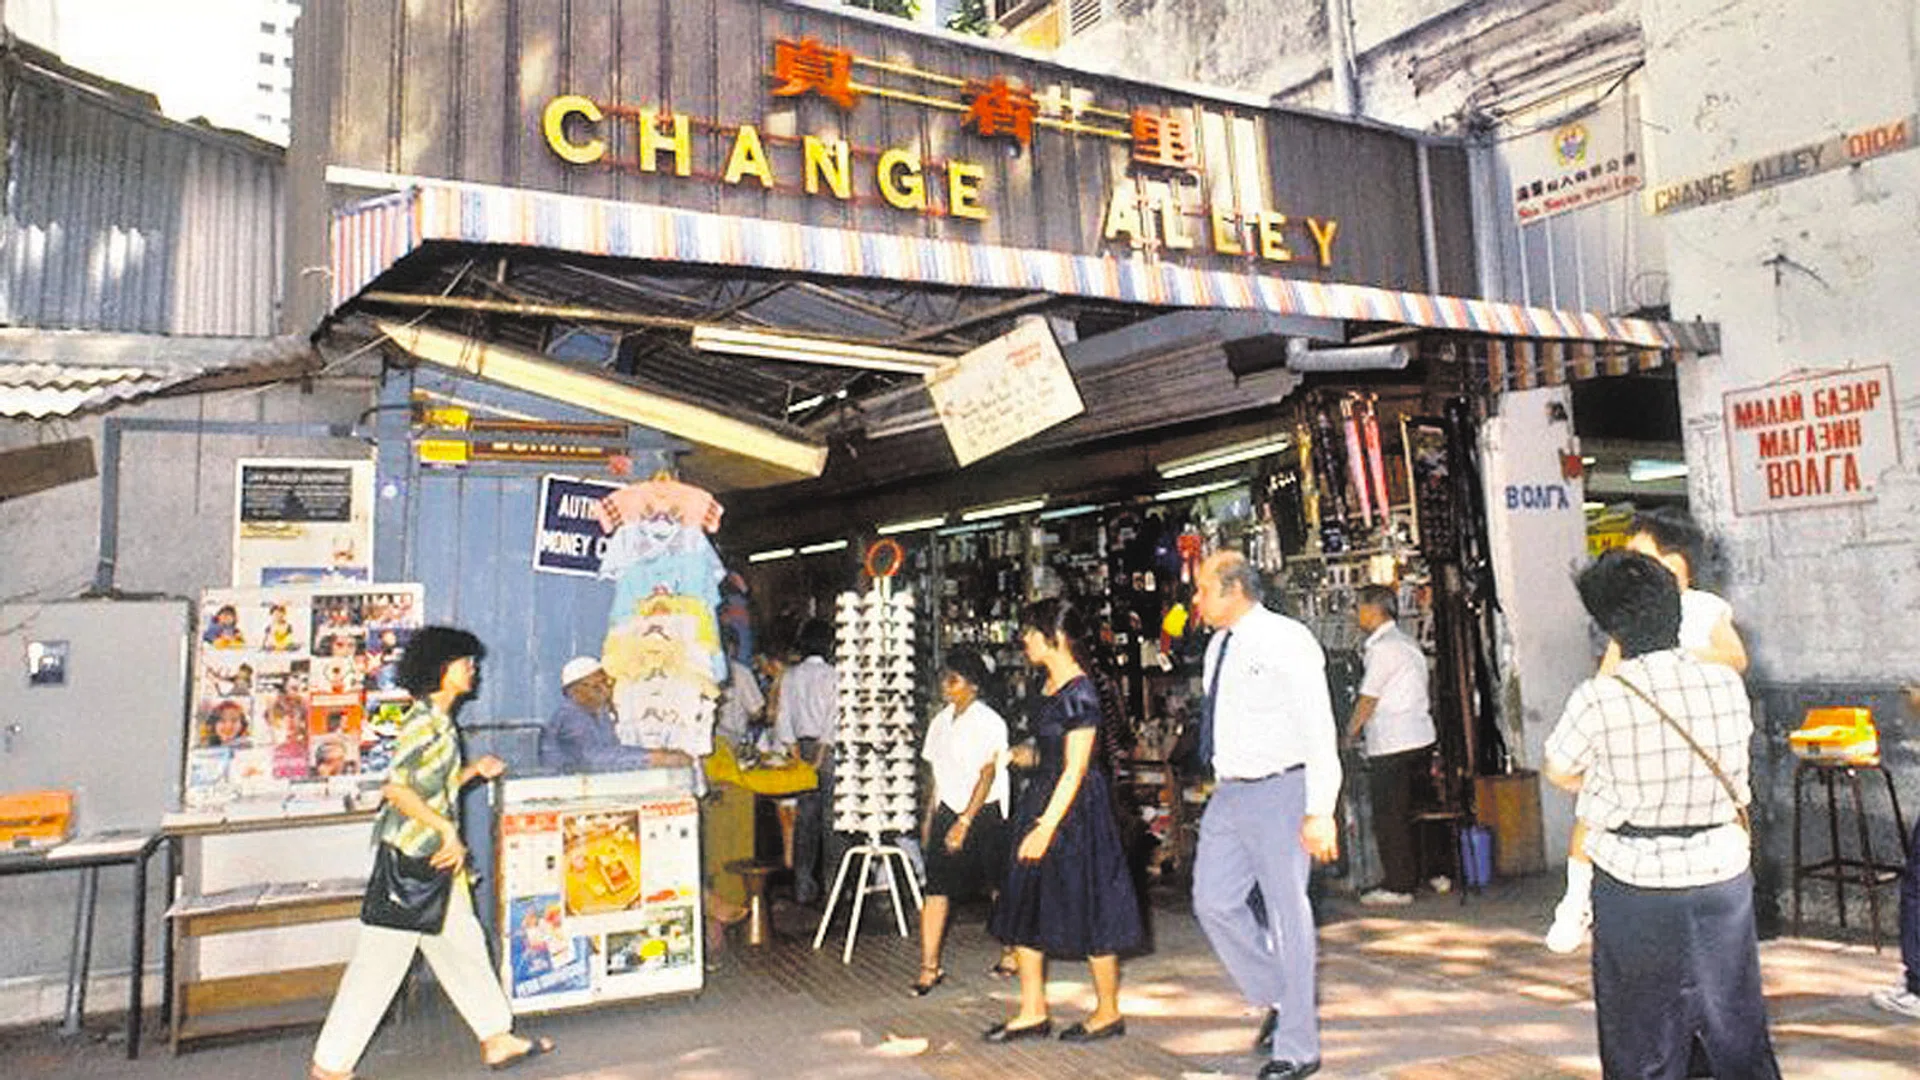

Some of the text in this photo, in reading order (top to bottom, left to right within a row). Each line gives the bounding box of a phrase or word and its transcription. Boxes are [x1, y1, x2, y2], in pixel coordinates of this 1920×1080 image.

[543, 95, 1338, 267] CHANGE ALLEY
[1654, 170, 1736, 214] CHANGE
[1752, 144, 1825, 185] ALLEY
[1733, 379, 1881, 431] МАЛАЙ БАЗАР
[1758, 417, 1863, 459] МАГАЗИН
[1505, 485, 1570, 509] ВОЛГА
[541, 529, 593, 556] MONEY
